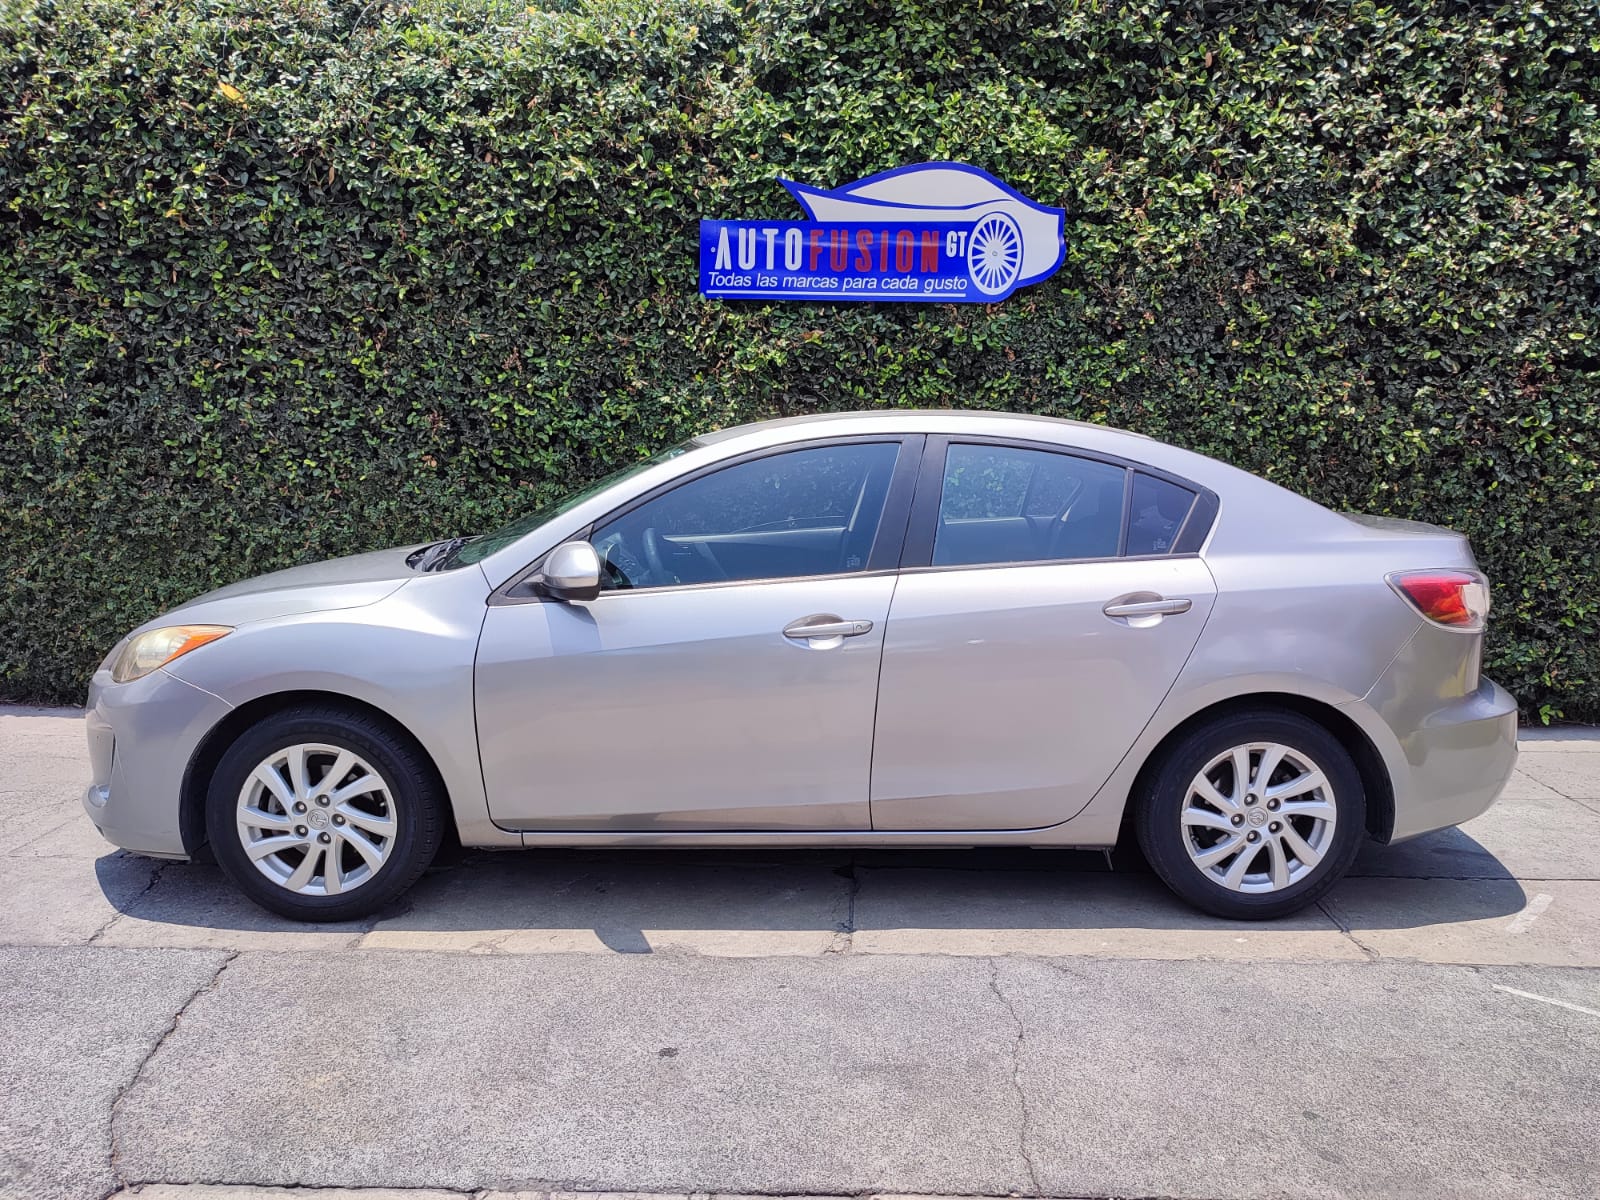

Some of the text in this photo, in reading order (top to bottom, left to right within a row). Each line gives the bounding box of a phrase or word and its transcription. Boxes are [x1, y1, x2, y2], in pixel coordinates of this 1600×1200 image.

[945, 231, 968, 257] GT
[708, 271, 968, 293] Todas las marcas para cada gusto
